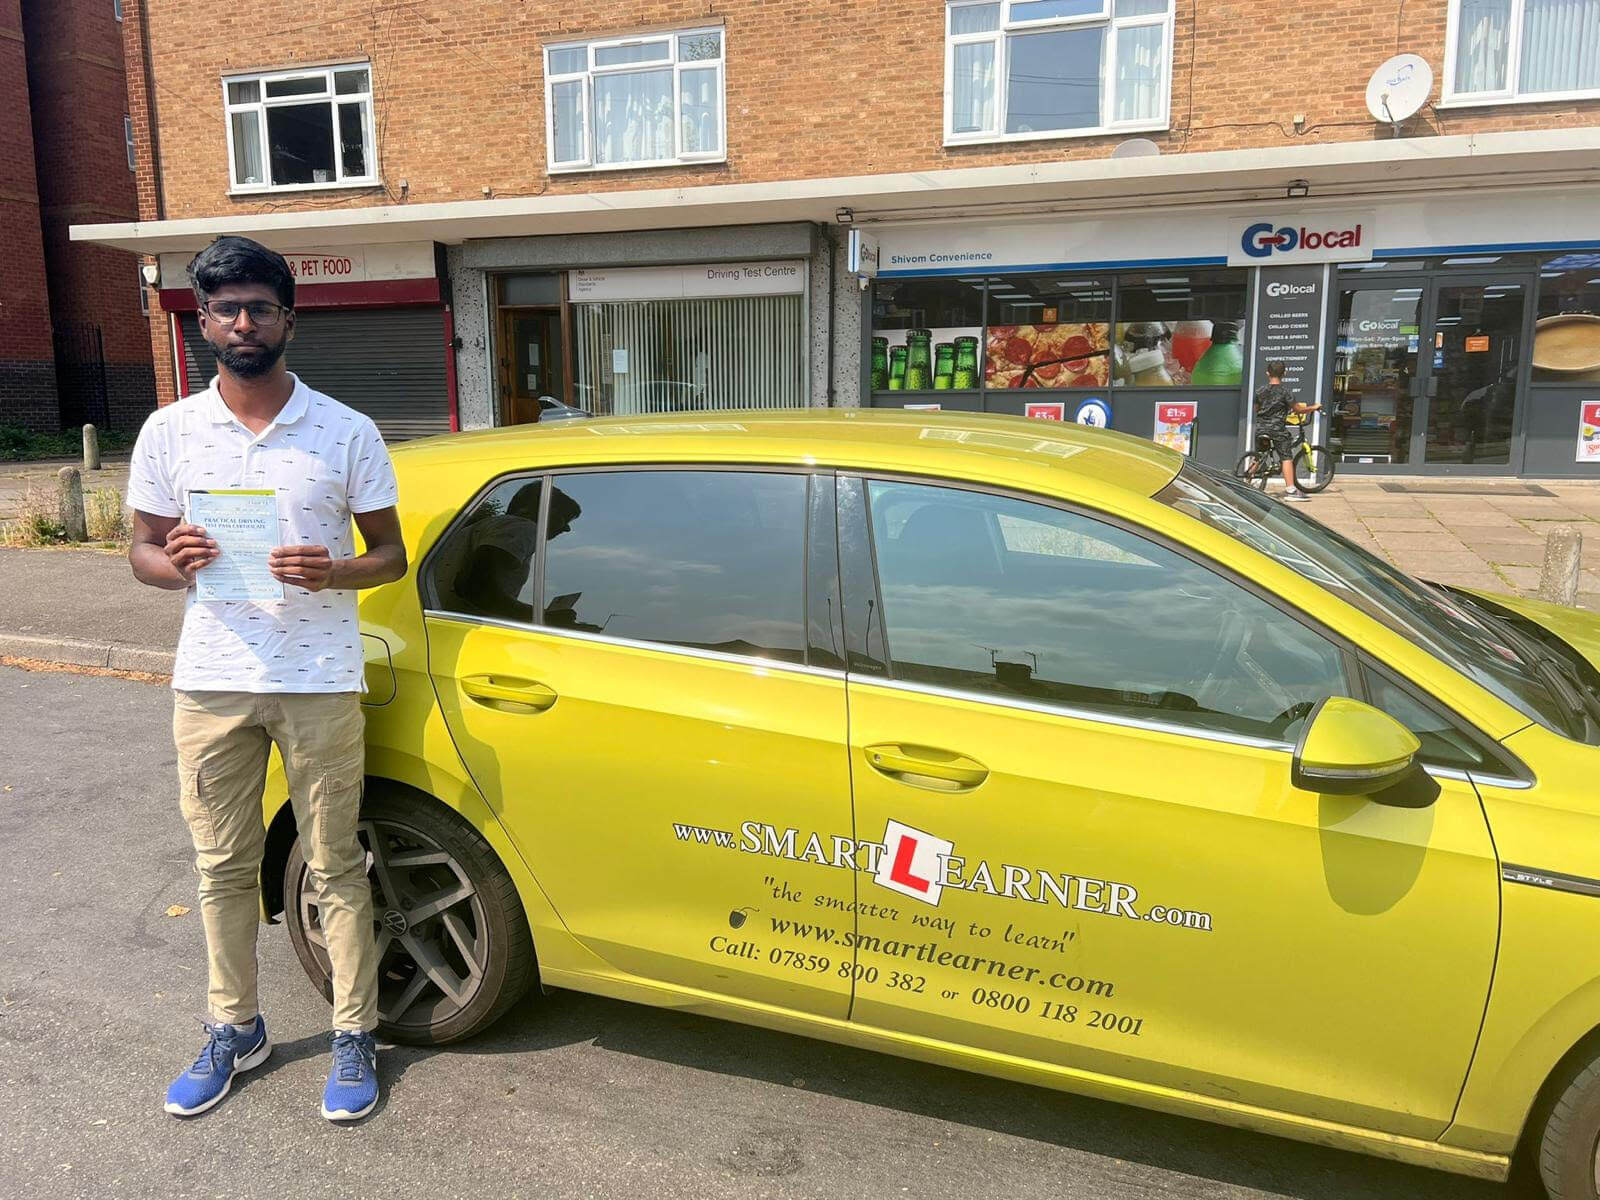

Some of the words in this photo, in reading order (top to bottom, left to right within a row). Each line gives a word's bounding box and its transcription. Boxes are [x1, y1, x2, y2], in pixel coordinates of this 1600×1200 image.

[289, 261, 298, 277] &
[301, 260, 319, 276] PET
[323, 258, 352, 275] FOOD
[707, 269, 740, 280] Driving
[742, 267, 762, 278] Test
[764, 266, 796, 276] Centre
[891, 255, 927, 264] Shivom
[929, 252, 993, 263] Convenience
[814, 894, 900, 922] smarter
[912, 913, 956, 939] way
[968, 921, 992, 938] to
[770, 916, 1115, 998] www.smartlearner.com
[709, 934, 761, 960] Call:
[769, 946, 831, 974] 07859
[837, 960, 880, 984] 800
[886, 970, 927, 994] 382
[941, 988, 960, 1001] or
[971, 986, 1032, 1014] 0800
[1039, 1000, 1079, 1024] 118
[1086, 1009, 1144, 1037] 2001
